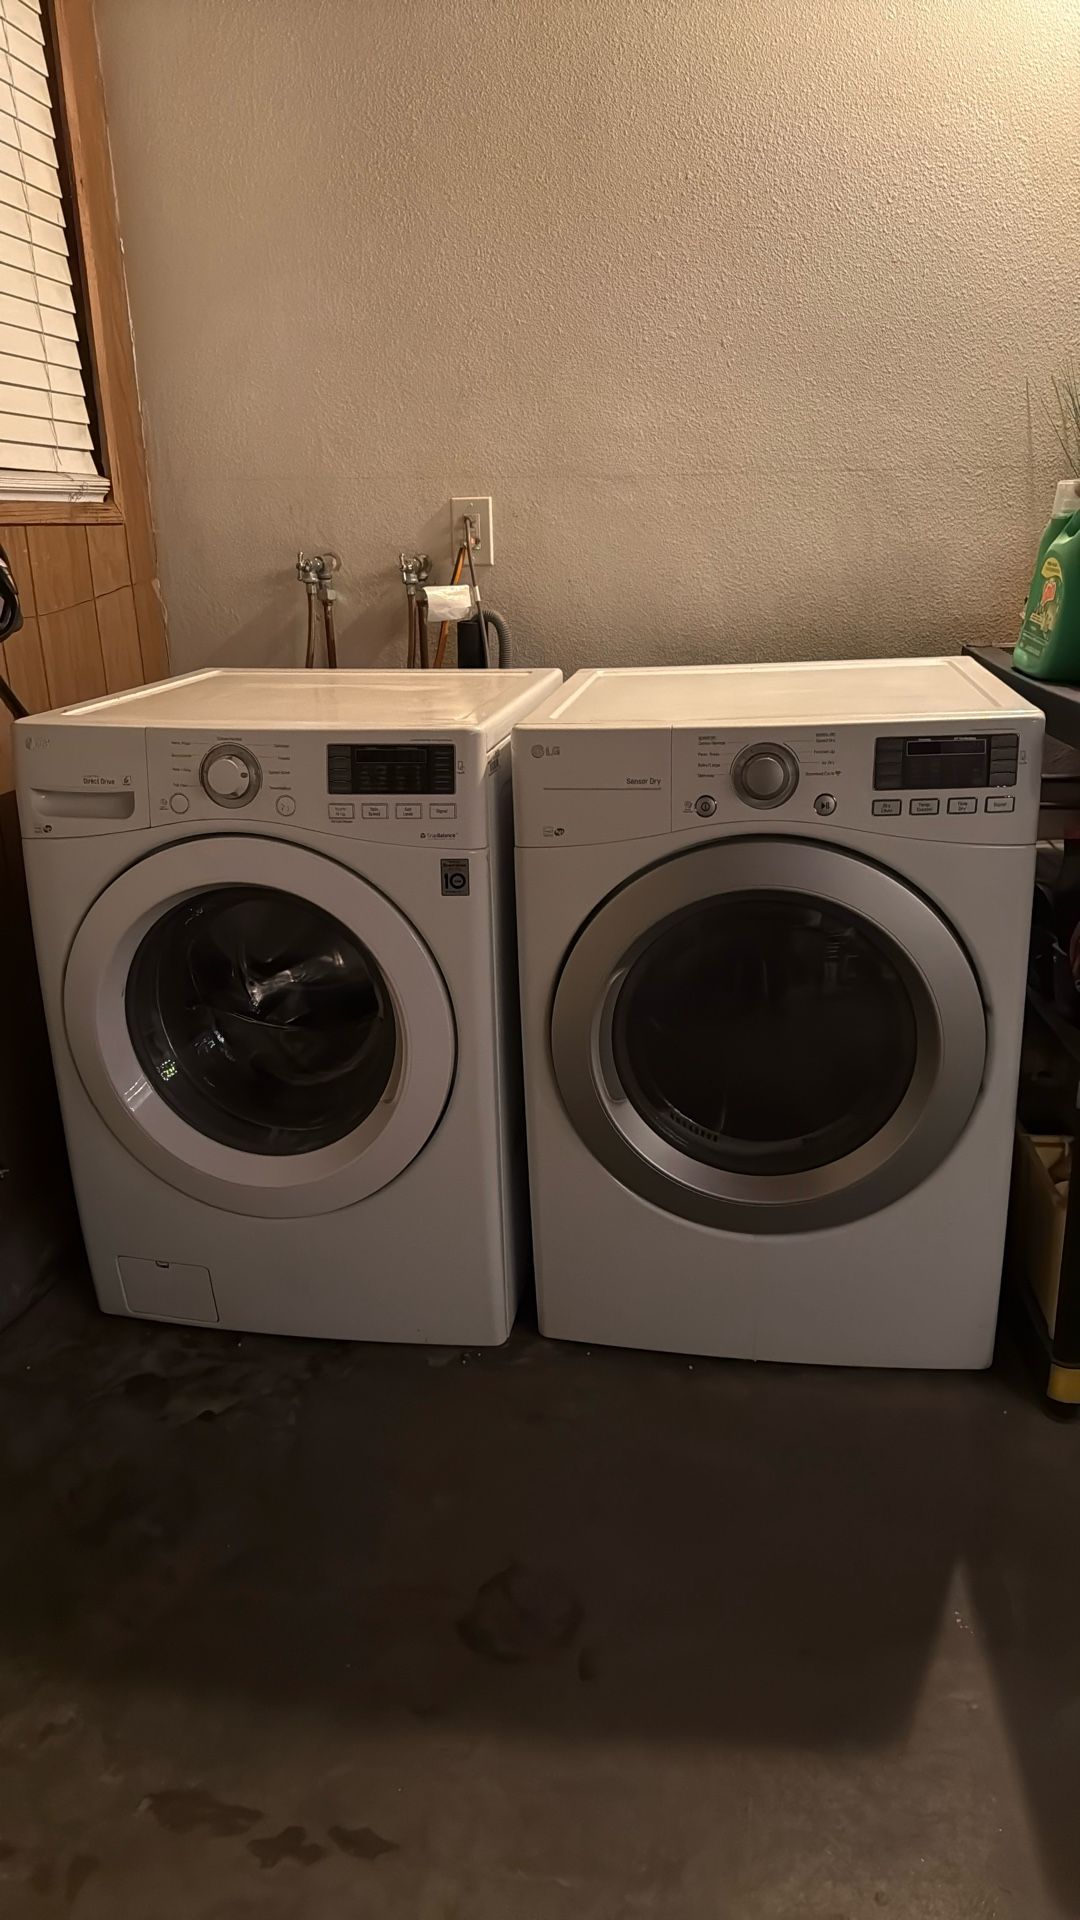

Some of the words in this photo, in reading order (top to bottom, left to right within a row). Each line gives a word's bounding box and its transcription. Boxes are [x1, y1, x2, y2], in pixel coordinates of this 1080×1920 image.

[100, 777, 115, 785] Drive
[626, 777, 648, 785] Sensor
[649, 777, 662, 786] Dry
